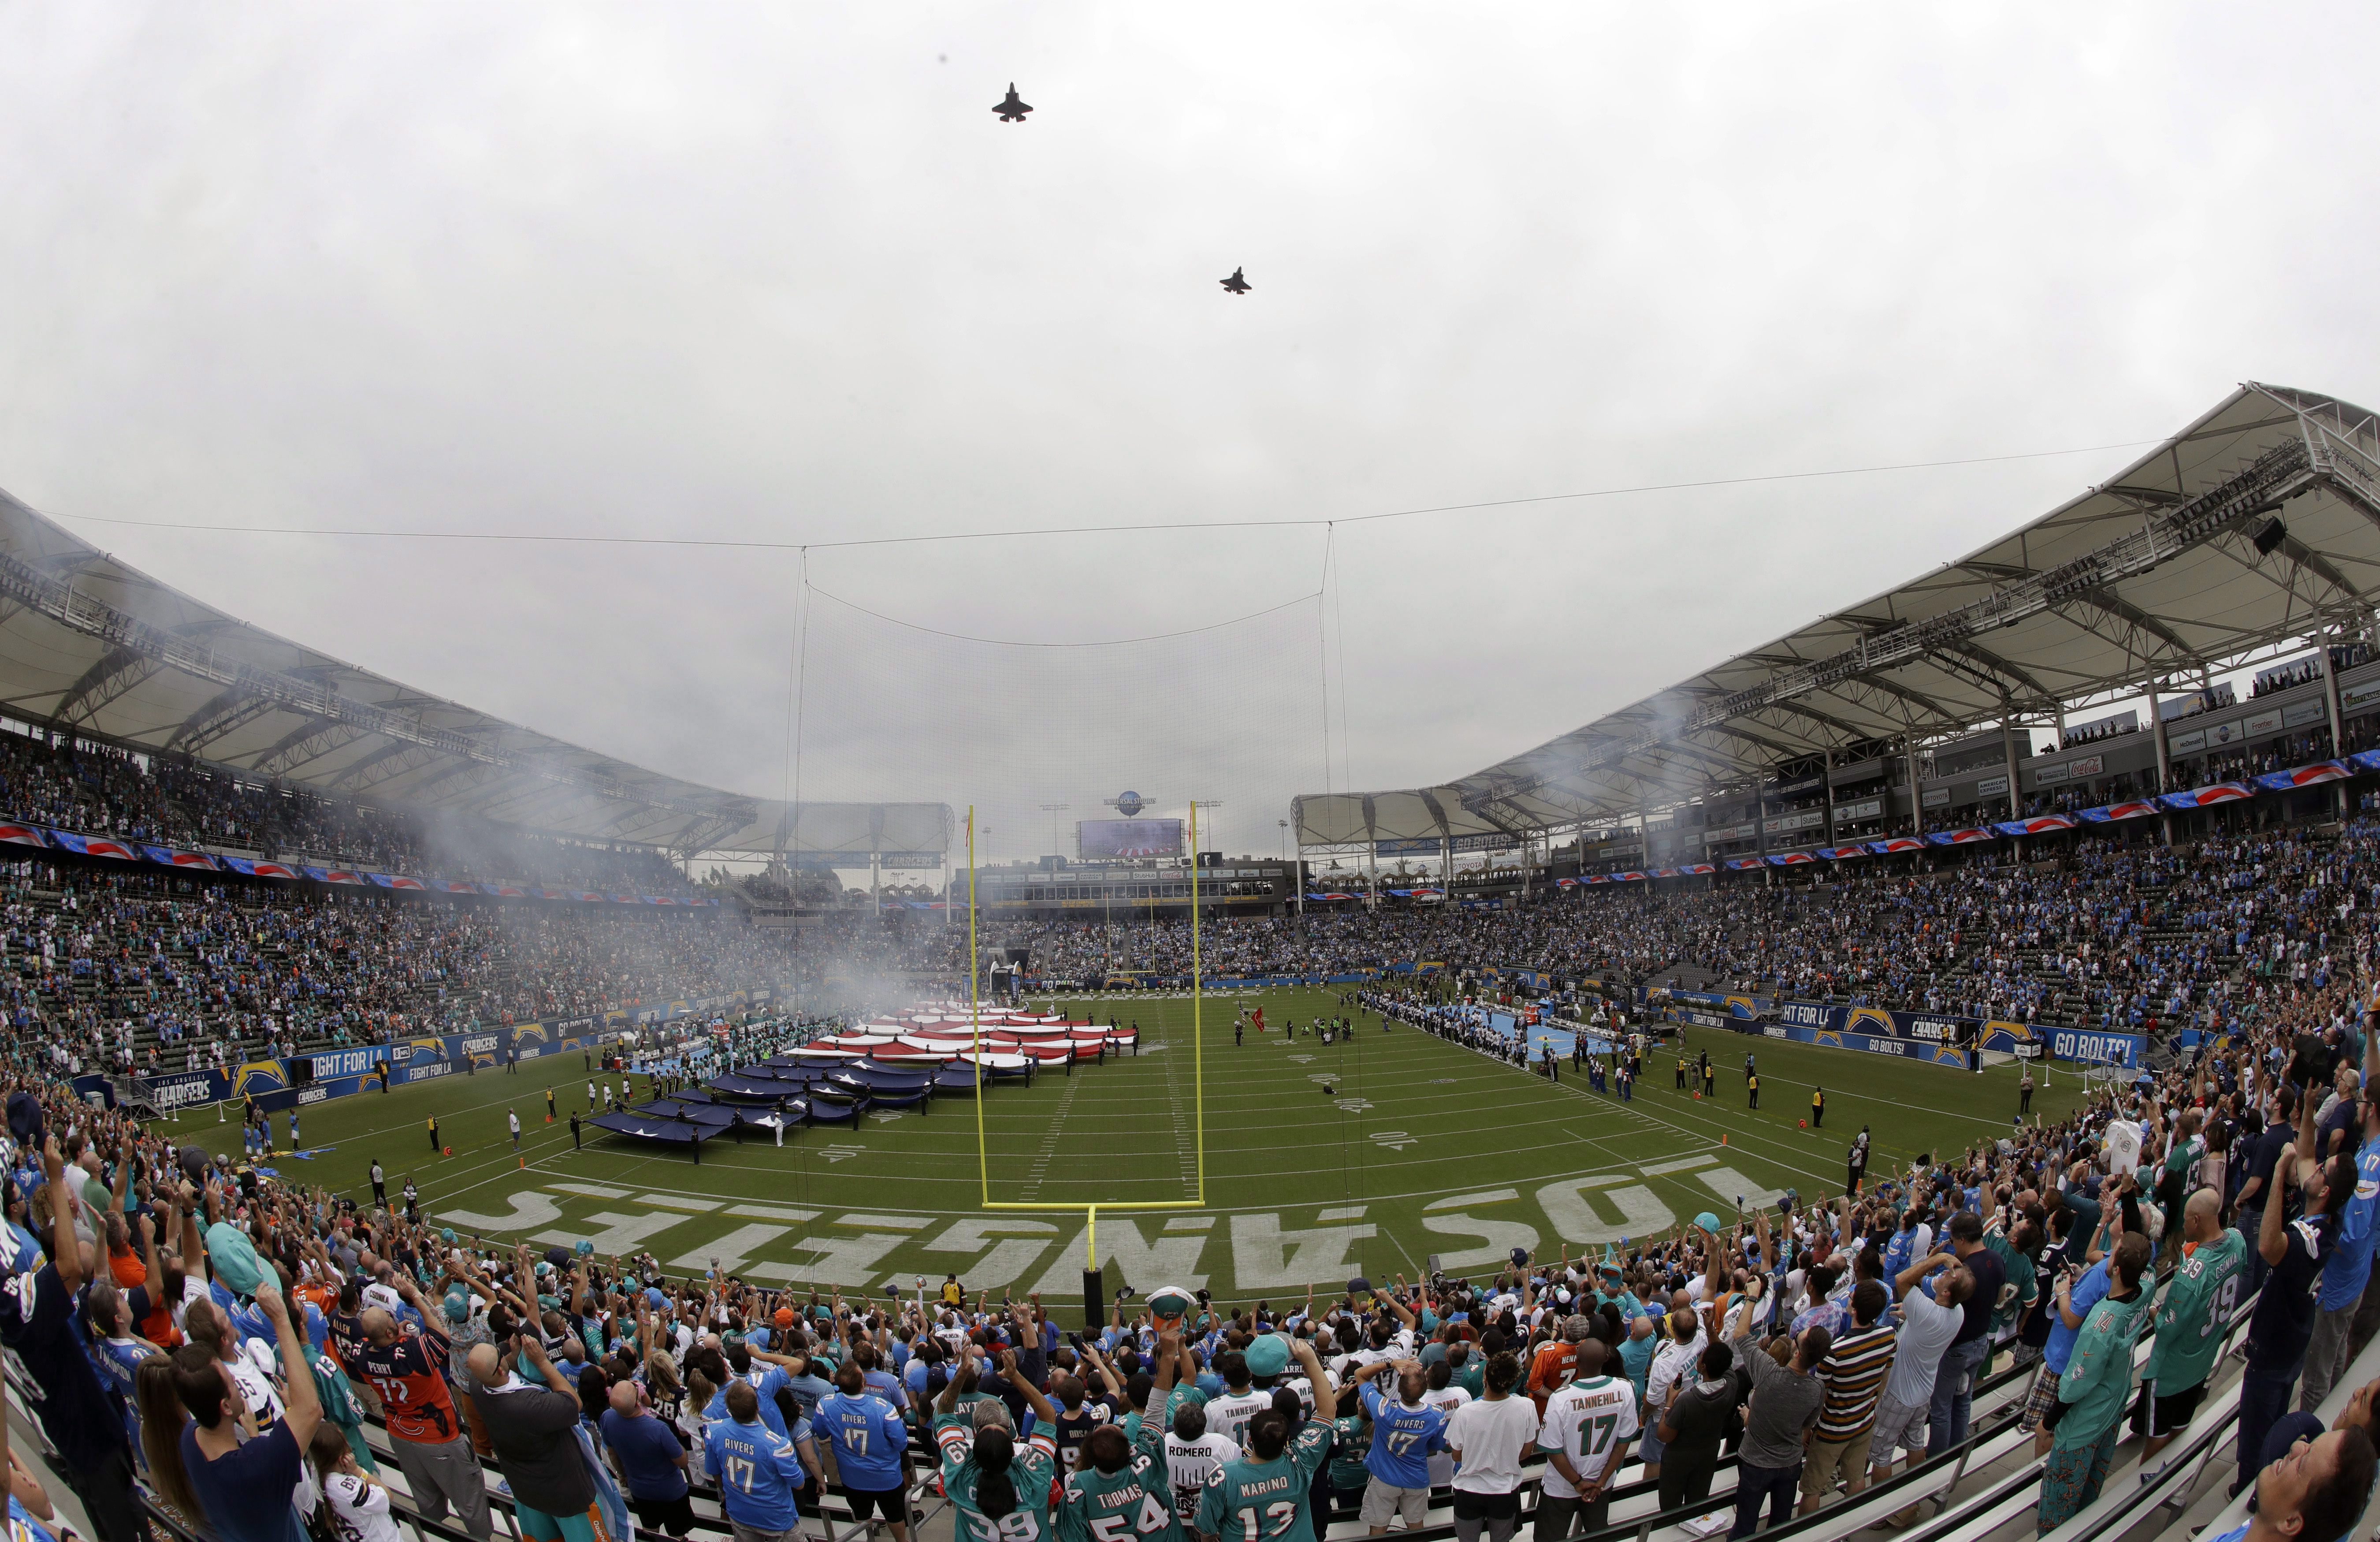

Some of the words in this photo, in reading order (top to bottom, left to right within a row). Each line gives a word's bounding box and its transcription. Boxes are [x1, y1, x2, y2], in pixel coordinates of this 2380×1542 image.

[2252, 719, 2273, 730] Frontier
[2179, 737, 2204, 748] McDonald's
[1979, 779, 2006, 789] AMERICAN
[1980, 785, 2003, 793] EXPRESS
[1803, 816, 1822, 825] StubHub
[1456, 837, 1471, 851] GO
[887, 856, 933, 867] CHARGERS
[1692, 1014, 1705, 1025] FIGHT
[1706, 1016, 1717, 1027] FOR
[1717, 1018, 1723, 1028] LA
[1797, 1005, 1817, 1024] FOR
[1819, 1008, 1829, 1025] LA
[558, 1022, 568, 1037] GO
[1763, 1026, 1787, 1038] CHARGERS
[462, 1035, 498, 1055] CHARGERS
[1869, 1039, 1879, 1051] GO
[1880, 1040, 1904, 1055] BOLTS!
[2054, 1032, 2076, 1057] GO
[519, 1047, 540, 1060] CHARGERS
[312, 1054, 342, 1078] IGHT
[343, 1051, 366, 1073] FOR
[369, 1049, 383, 1069] LA
[409, 1065, 430, 1080] FIGHT
[430, 1063, 443, 1076] FOR
[443, 1062, 452, 1074] LA
[175, 1074, 205, 1085] ANGELES
[154, 1079, 210, 1108] CHARGERS
[298, 1087, 327, 1104] CHARGERS
[2364, 1154, 2380, 1172] 17
[2183, 1159, 2201, 1196] 13
[1893, 1237, 1901, 1246] 17
[2182, 1257, 2203, 1279] 39
[297, 1289, 308, 1304] 54
[369, 1289, 390, 1305] CSONKA
[2200, 1272, 2239, 1338] 39
[230, 1303, 242, 1315] 17
[403, 1310, 420, 1321] RIVERS
[333, 1319, 351, 1336] ALLEN
[2094, 1310, 2114, 1333] 14
[2124, 1302, 2149, 1338] LANDRY
[314, 1355, 338, 1378] 13
[369, 1361, 394, 1375] PERRY
[1562, 1355, 1577, 1365] HENN
[374, 1378, 411, 1404] 72
[653, 1397, 675, 1420] 28
[953, 1401, 979, 1415] LAYT
[1569, 1390, 1624, 1411] TANNEHILL
[842, 1413, 866, 1424] RIVERS
[1394, 1419, 1425, 1430] RIVERS
[765, 1430, 782, 1445] 17
[843, 1427, 869, 1456] 17
[1069, 1429, 1088, 1439] BOSA
[1577, 1412, 1618, 1456] 17
[725, 1437, 755, 1456] RIVERS
[1168, 1445, 1212, 1457] ROMERO
[1386, 1431, 1420, 1456] 17
[725, 1454, 756, 1494] 17
[1241, 1476, 1288, 1497] MARINO
[1097, 1483, 1144, 1508] THOMAS
[1089, 1490, 1171, 1542] 54
[1237, 1501, 1297, 1542] 13
